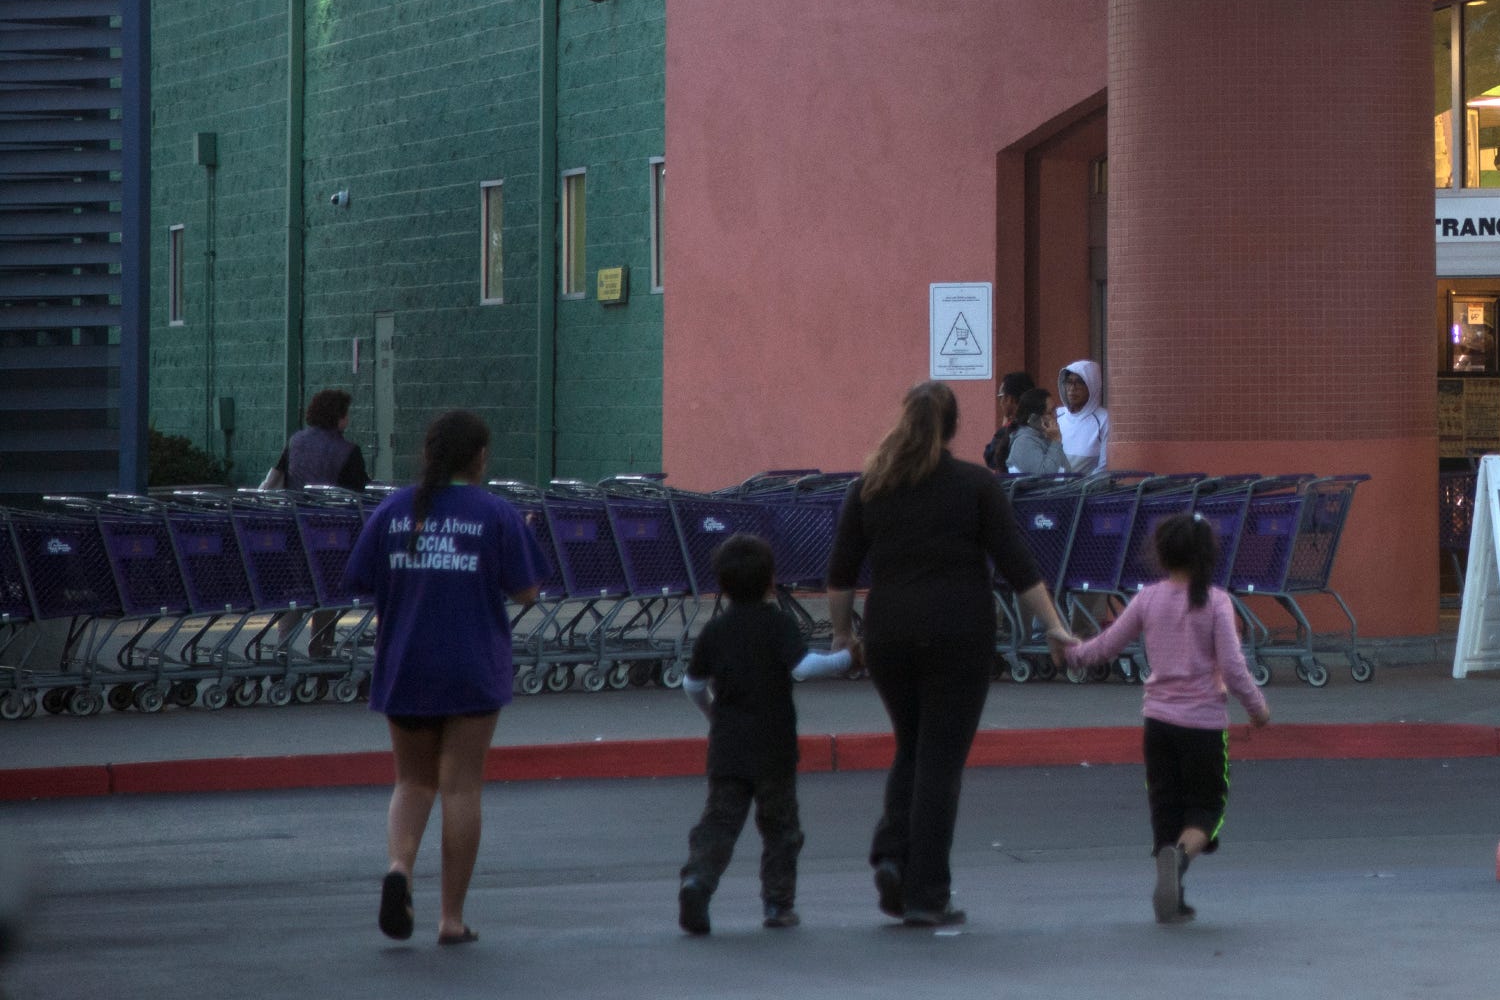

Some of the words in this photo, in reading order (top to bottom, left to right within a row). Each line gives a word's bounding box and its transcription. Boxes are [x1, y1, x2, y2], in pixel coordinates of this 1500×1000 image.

[389, 517, 411, 533] Ask
[441, 518, 482, 535] About
[416, 536, 456, 552] OCIAL
